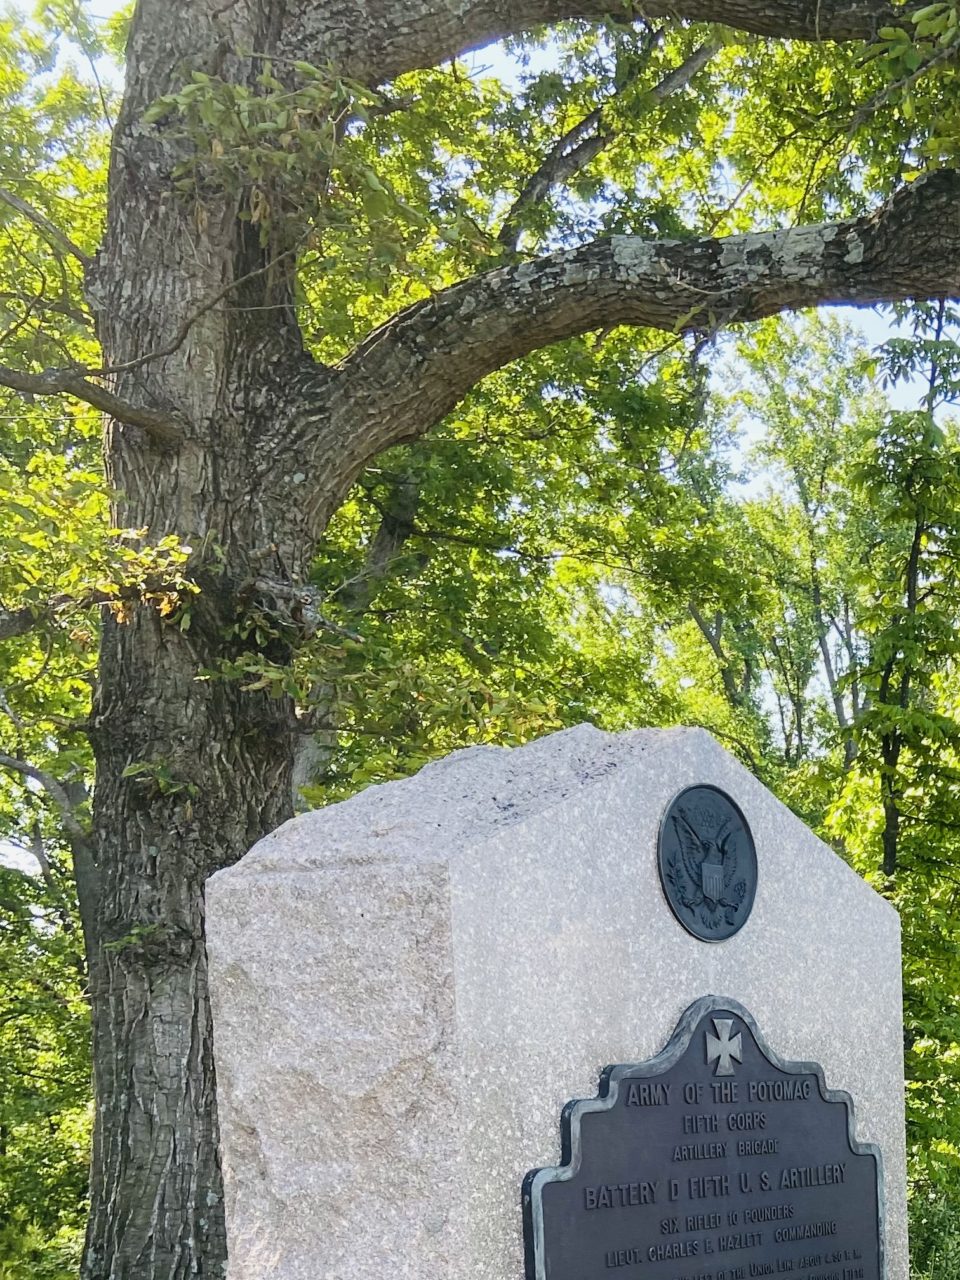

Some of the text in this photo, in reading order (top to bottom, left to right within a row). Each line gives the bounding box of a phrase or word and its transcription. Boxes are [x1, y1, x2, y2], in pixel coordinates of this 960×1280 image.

[626, 1081, 809, 1104] ARMY OF THE POTOMAC
[684, 1113, 766, 1132] FIFTH CORPS
[672, 1140, 779, 1160] ARTILLERY BRIGADE
[584, 1182, 657, 1209] BATTERY
[669, 1179, 679, 1201] D
[689, 1176, 730, 1198] FIFTH
[740, 1173, 752, 1194] U.
[780, 1166, 846, 1189] ARTILLERY
[659, 1205, 794, 1234] SIX RIFLED 10 POUNDERS
[606, 1248, 641, 1266] LIEUT.
[648, 1240, 698, 1260] CHARLES
[719, 1232, 762, 1250] HAZLETT
[775, 1222, 837, 1242] COMMANDING
[730, 1264, 745, 1280] THE
[750, 1261, 773, 1276] UNION
[777, 1257, 793, 1272] LINE
[799, 1253, 821, 1267] ABOUT
